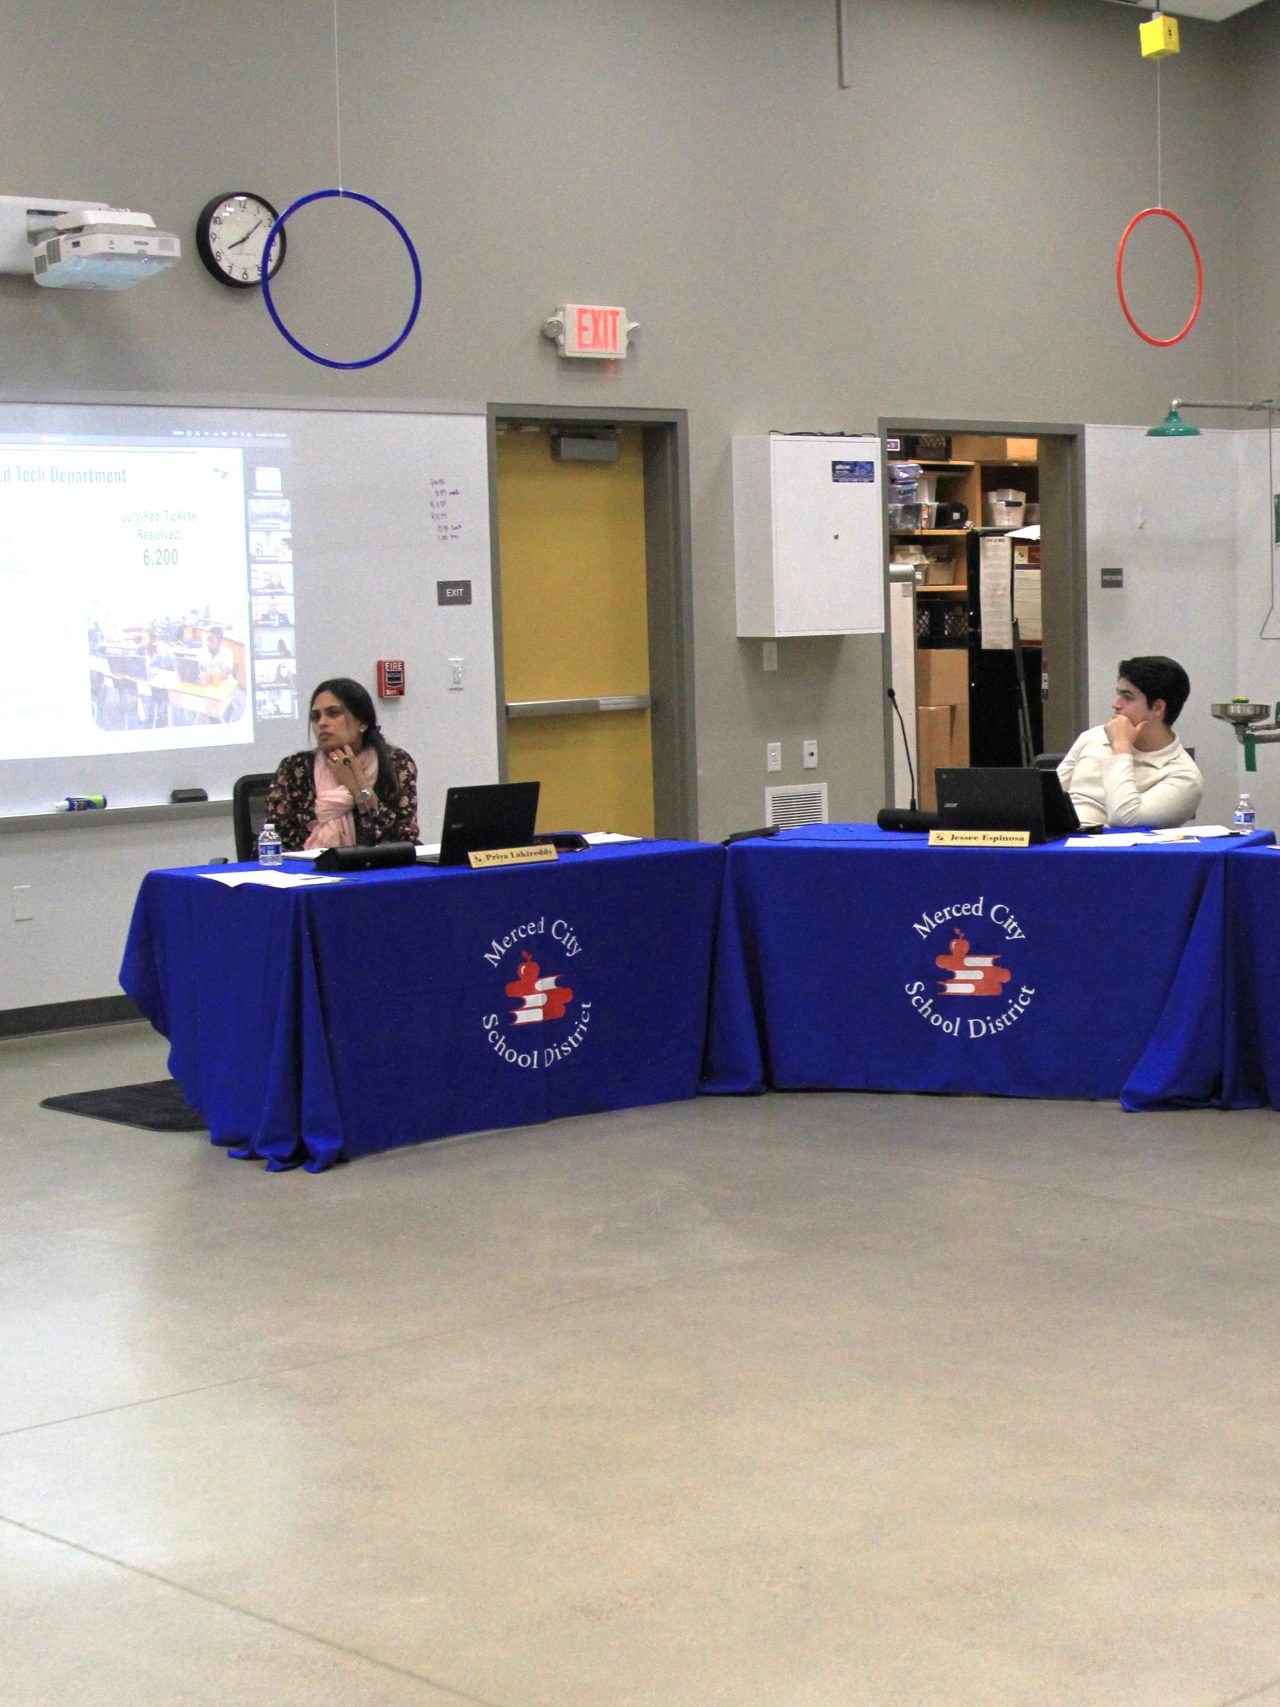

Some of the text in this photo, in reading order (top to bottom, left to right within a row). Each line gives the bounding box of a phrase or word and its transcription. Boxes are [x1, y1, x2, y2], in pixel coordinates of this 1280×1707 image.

[576, 308, 620, 352] EXIT
[50, 464, 128, 487] Department
[446, 588, 465, 598] EXIT
[384, 661, 403, 672] FIRE
[982, 834, 1025, 843] Espinosa
[485, 853, 509, 862] Priya
[911, 896, 1026, 940] Merced City
[483, 916, 582, 968] Merced City
[904, 981, 1036, 1039] School District
[482, 1000, 592, 1069] School District
